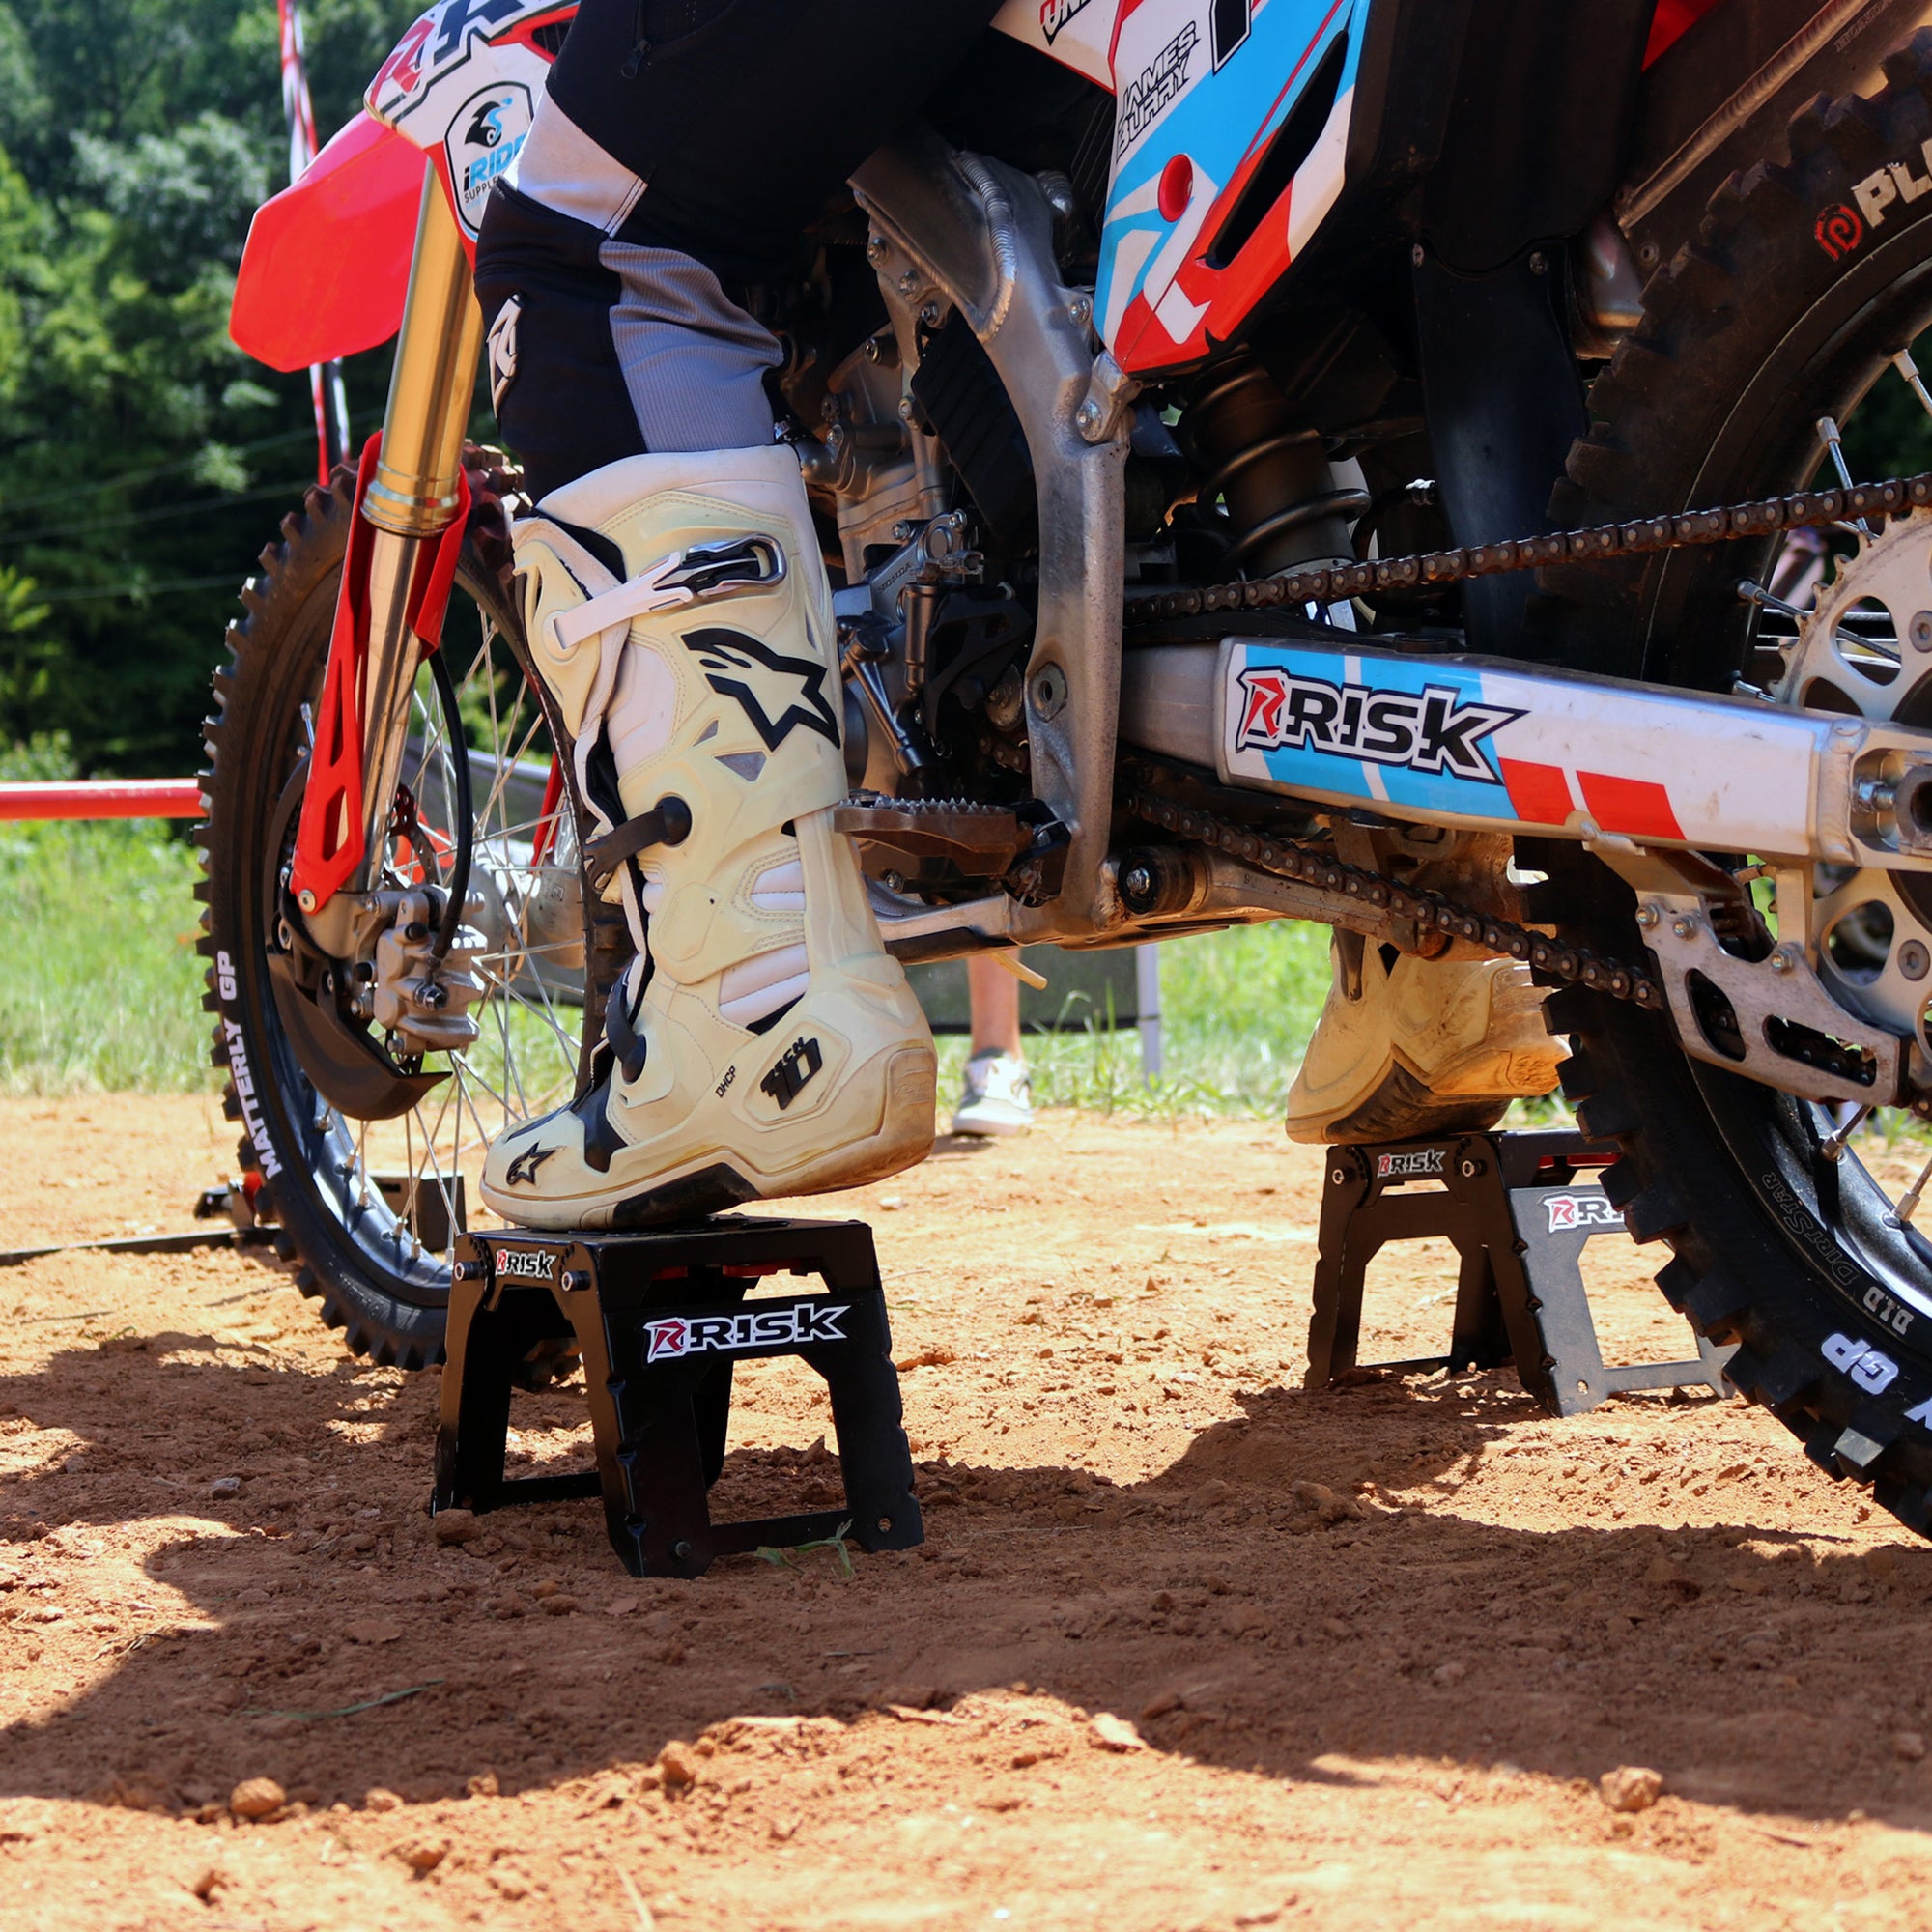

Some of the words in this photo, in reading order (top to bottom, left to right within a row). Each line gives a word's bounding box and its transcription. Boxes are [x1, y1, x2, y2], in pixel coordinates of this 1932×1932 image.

[1116, 49, 1192, 164] BURRY
[1121, 19, 1201, 121] JAMES
[217, 950, 237, 1001] GP
[222, 1016, 283, 1179] MATTERLY
[766, 1037, 823, 1111] 10
[1820, 1332, 1899, 1395] GP
